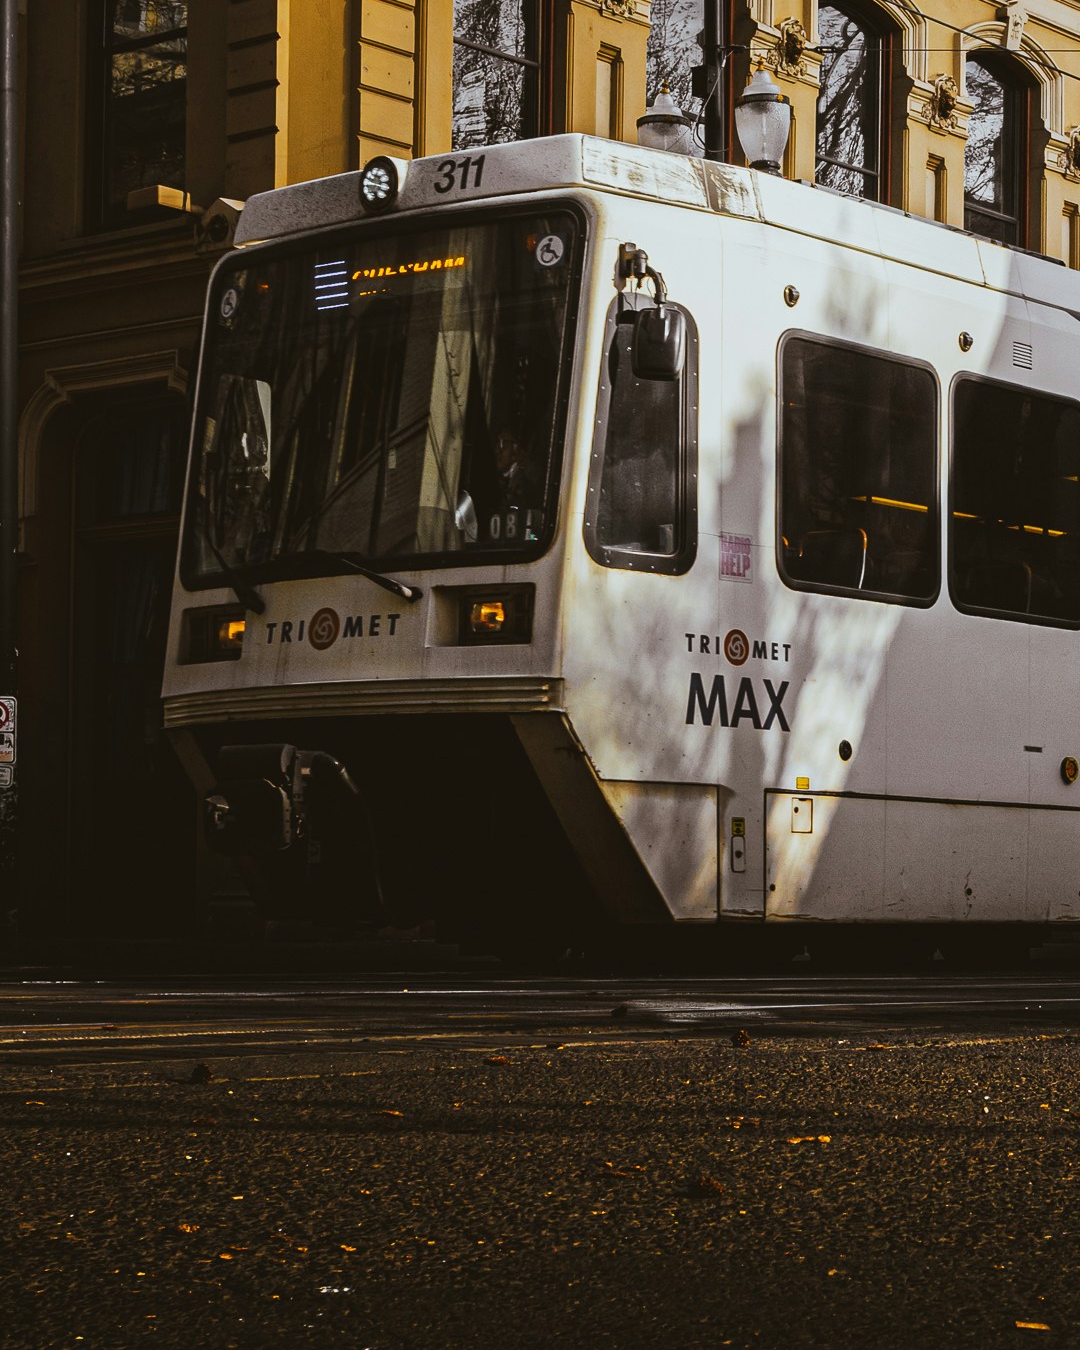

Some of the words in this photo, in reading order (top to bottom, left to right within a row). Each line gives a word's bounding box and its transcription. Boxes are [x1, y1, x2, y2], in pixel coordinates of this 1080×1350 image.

[434, 154, 486, 194] 311
[721, 553, 750, 577] HELP
[685, 672, 791, 733] MAX
